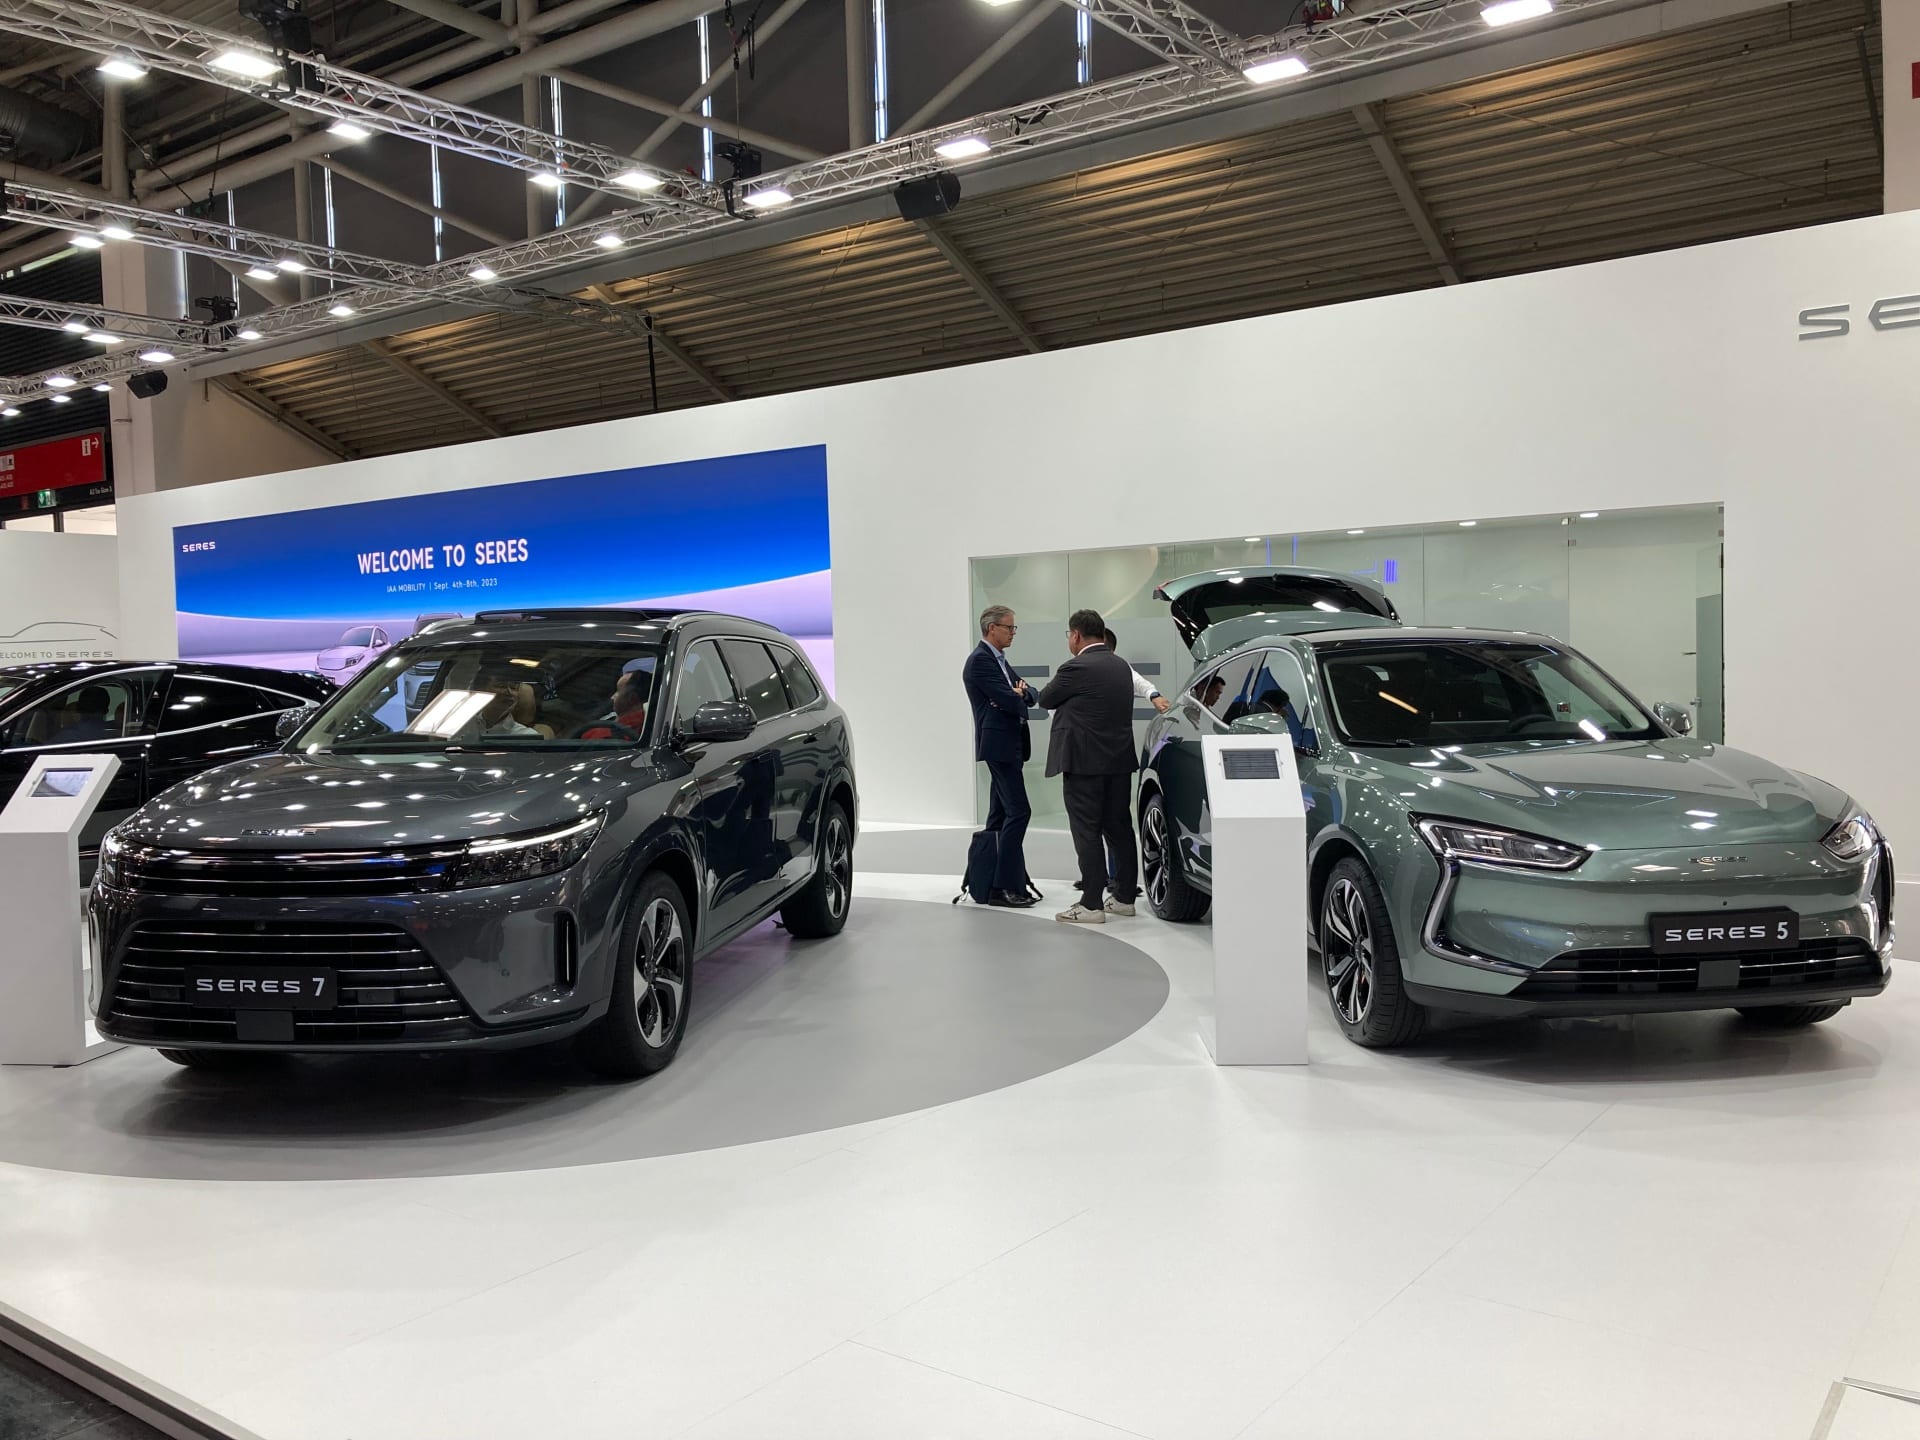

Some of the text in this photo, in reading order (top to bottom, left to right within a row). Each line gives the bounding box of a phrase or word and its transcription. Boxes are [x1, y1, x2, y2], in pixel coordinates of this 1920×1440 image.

[182, 541, 216, 553] SERES
[357, 538, 529, 575] WELCOME TO SERES
[386, 585, 397, 593] IAA
[398, 582, 426, 592] MOBILITY
[481, 577, 498, 587] 2023
[1665, 921, 1789, 942] SERES 5
[196, 977, 325, 997] SERES 7
